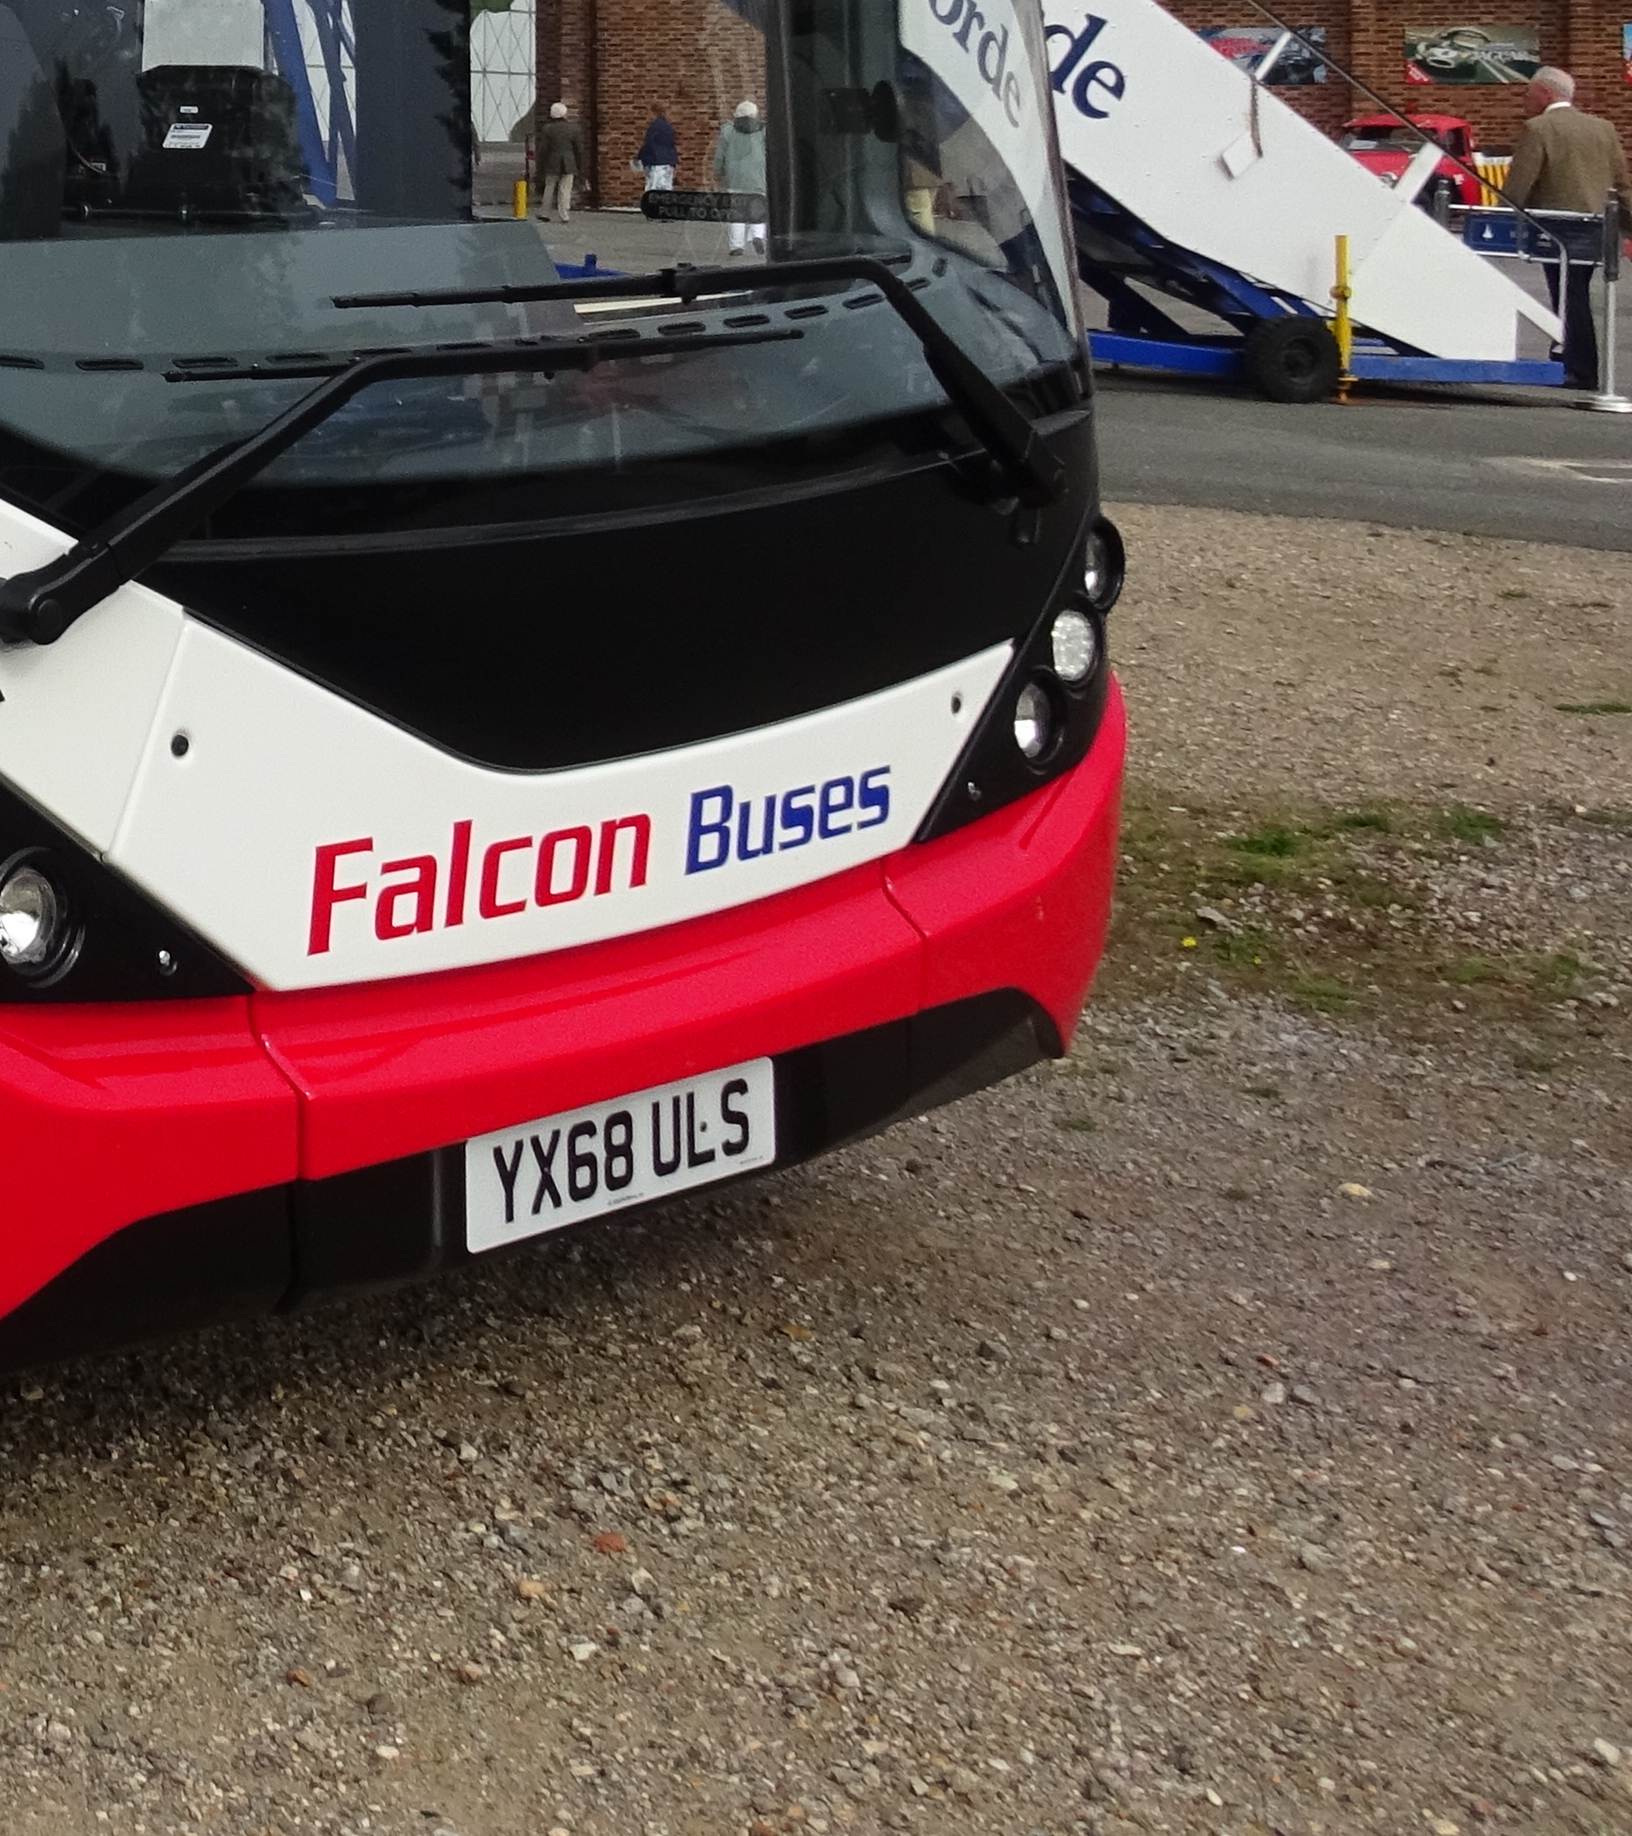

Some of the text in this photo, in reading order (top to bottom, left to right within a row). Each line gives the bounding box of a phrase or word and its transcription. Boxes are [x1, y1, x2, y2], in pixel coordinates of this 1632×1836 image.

[306, 764, 892, 957] Falcon Buses
[491, 1077, 751, 1225] YX68 ULS
